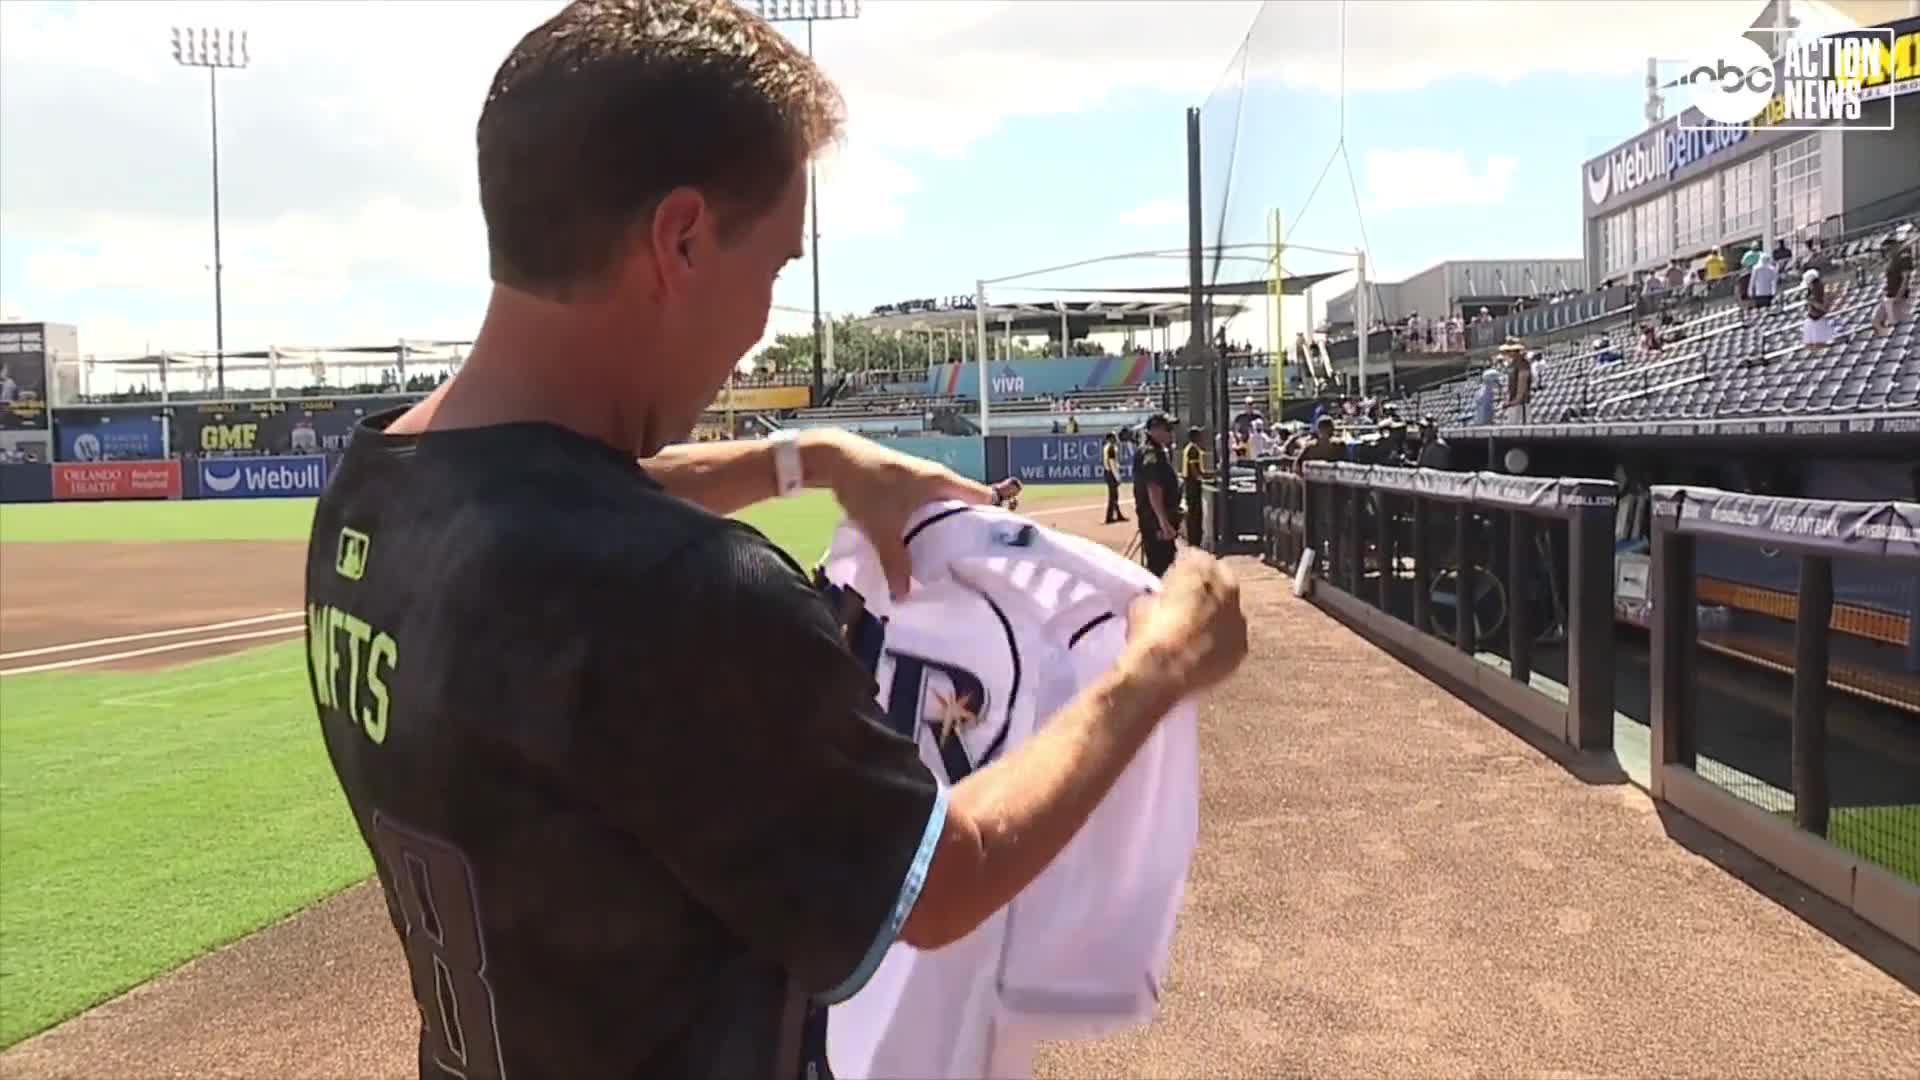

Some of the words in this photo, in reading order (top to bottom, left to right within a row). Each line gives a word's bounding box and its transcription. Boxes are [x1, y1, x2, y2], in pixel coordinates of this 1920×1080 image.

[201, 423, 258, 450] GMF
[245, 463, 321, 490] Webull
[1020, 466, 1045, 479] WE
[1048, 465, 1092, 479] MAKE
[309, 602, 398, 745] WFTS
